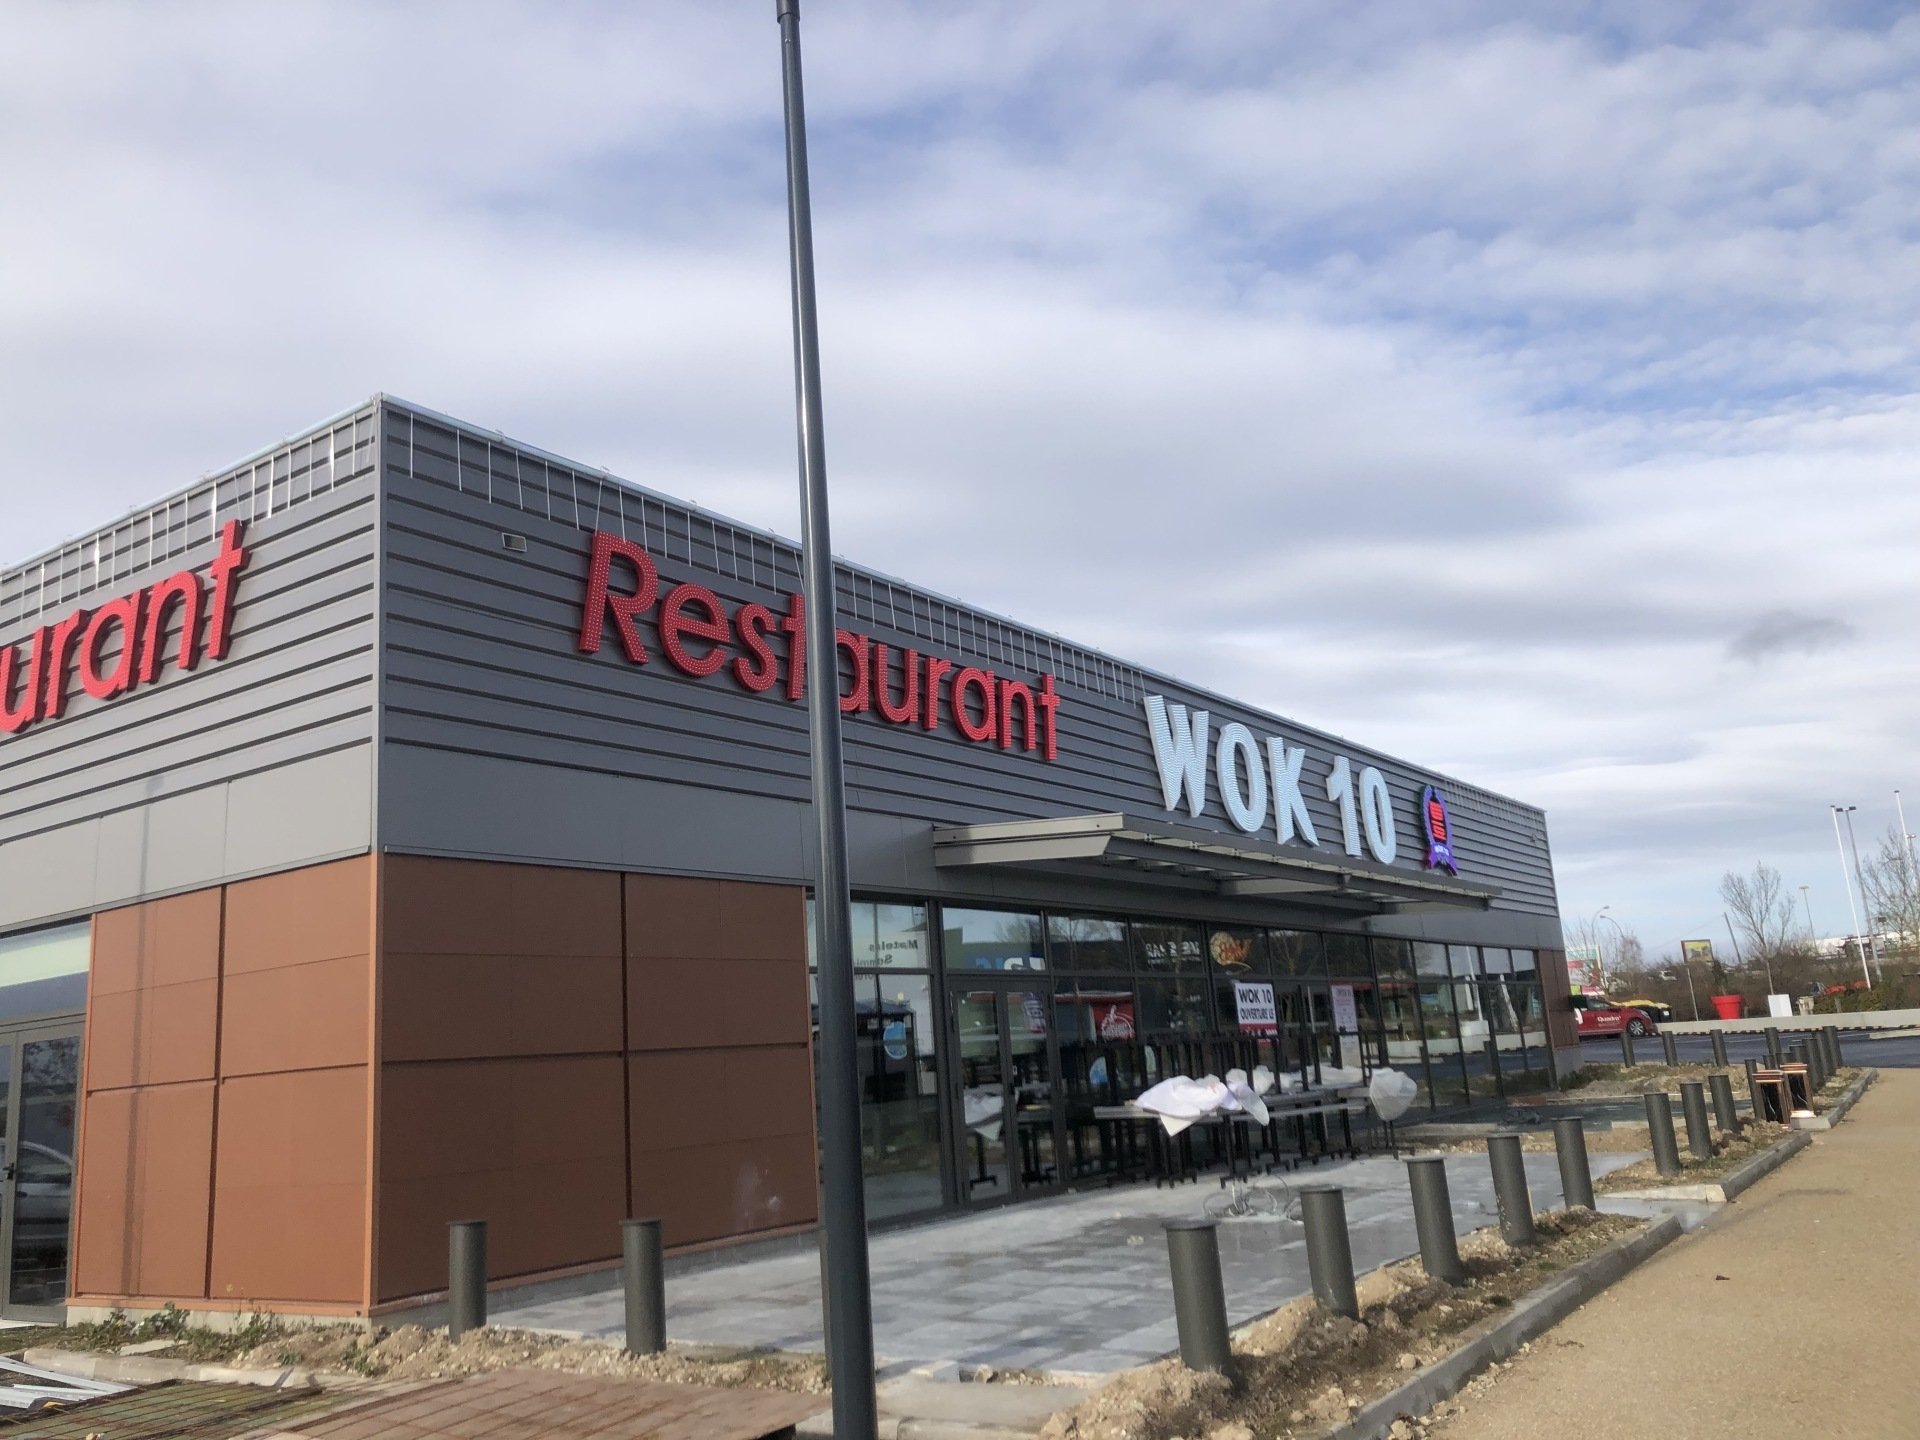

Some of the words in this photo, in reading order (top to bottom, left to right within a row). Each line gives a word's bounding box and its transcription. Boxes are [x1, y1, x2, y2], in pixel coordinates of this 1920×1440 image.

[578, 530, 1061, 761] Restaurant
[1143, 694, 1320, 847] WOK
[1325, 755, 1397, 865] 10
[1238, 988, 1261, 1003] WOK
[1262, 989, 1272, 1004] 10
